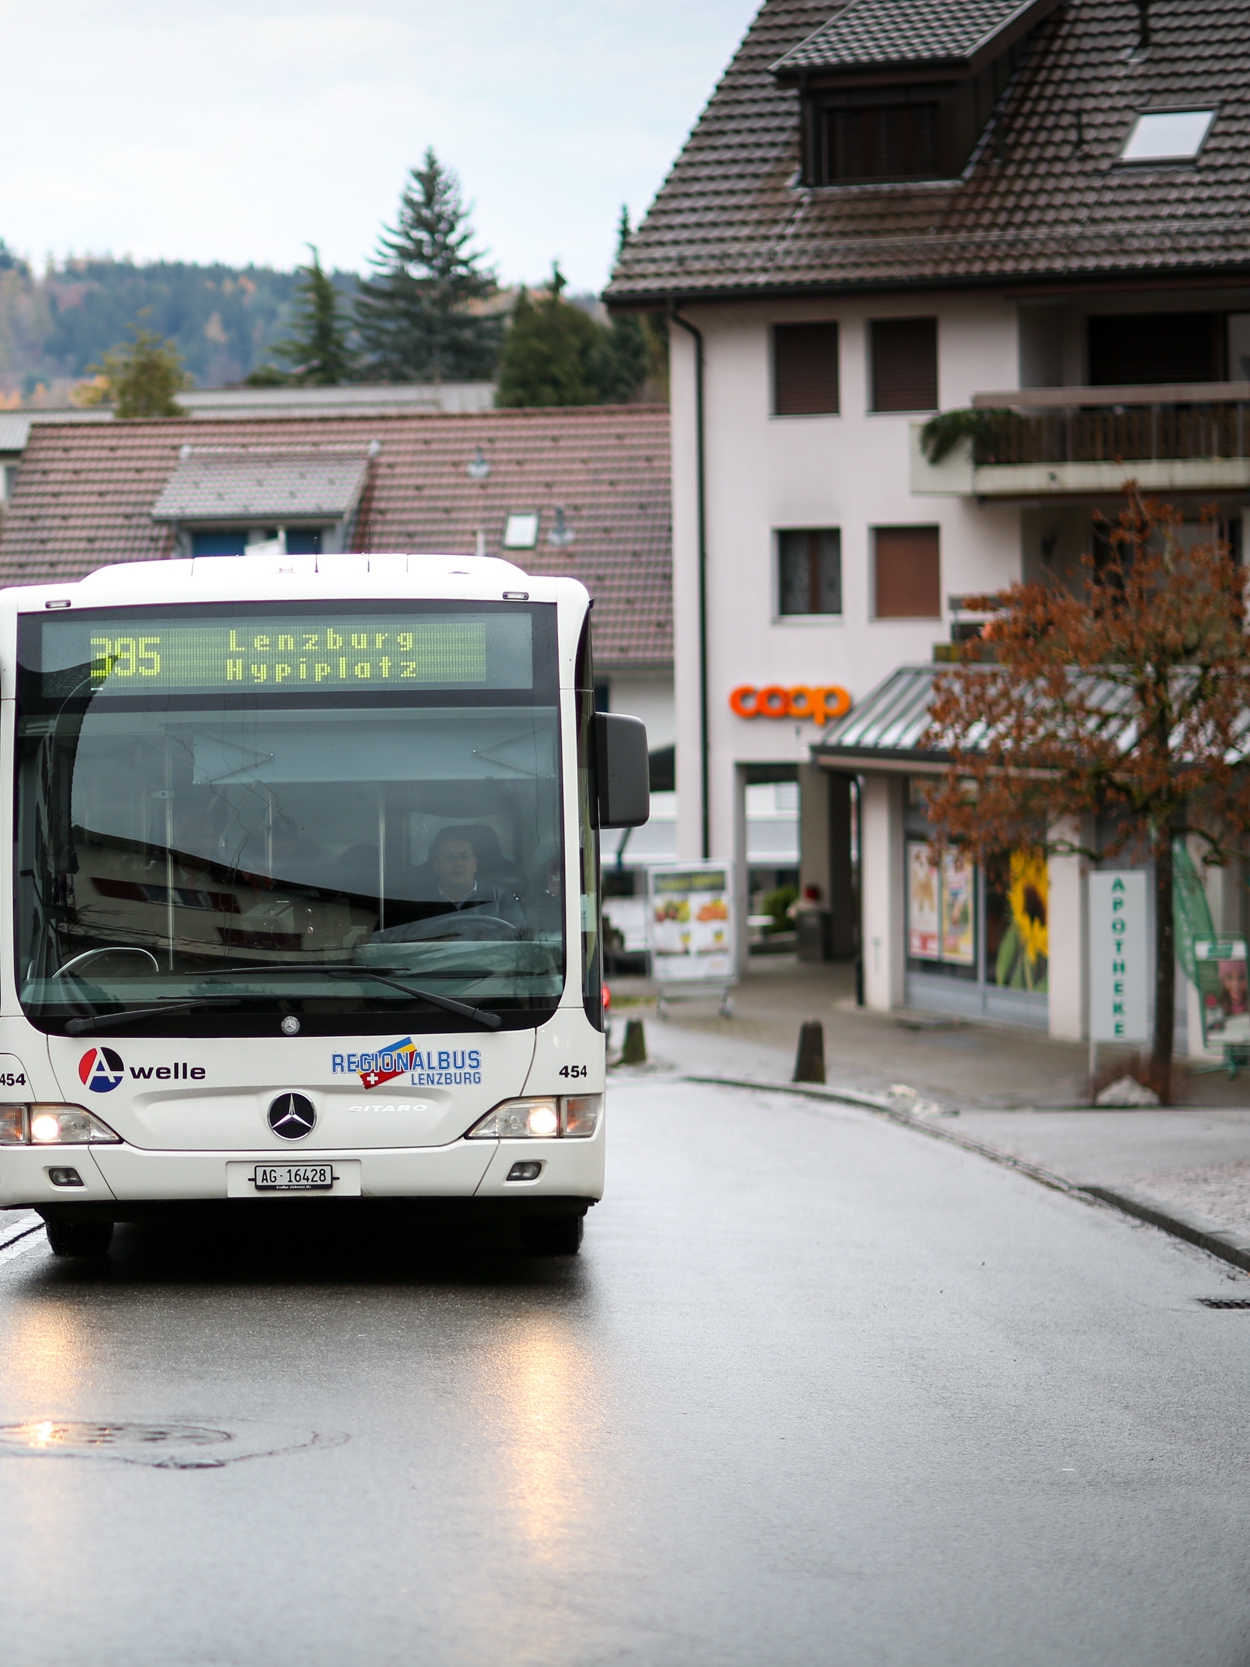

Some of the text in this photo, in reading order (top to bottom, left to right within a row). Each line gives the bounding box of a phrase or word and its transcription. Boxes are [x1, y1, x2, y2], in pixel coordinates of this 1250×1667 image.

[91, 628, 414, 677] 395 Lenzburg
[226, 656, 418, 683] Hypiplatz
[729, 685, 851, 726] coop
[1111, 876, 1126, 1037] APOTHEKE
[129, 1062, 206, 1080] welle
[332, 1050, 481, 1074] REGIONALBUS
[0, 1073, 26, 1086] 454
[411, 1072, 481, 1085] LENZBURG
[559, 1065, 587, 1078] 454
[348, 1104, 428, 1113] CITARO
[261, 1168, 326, 1183] AG 16428
